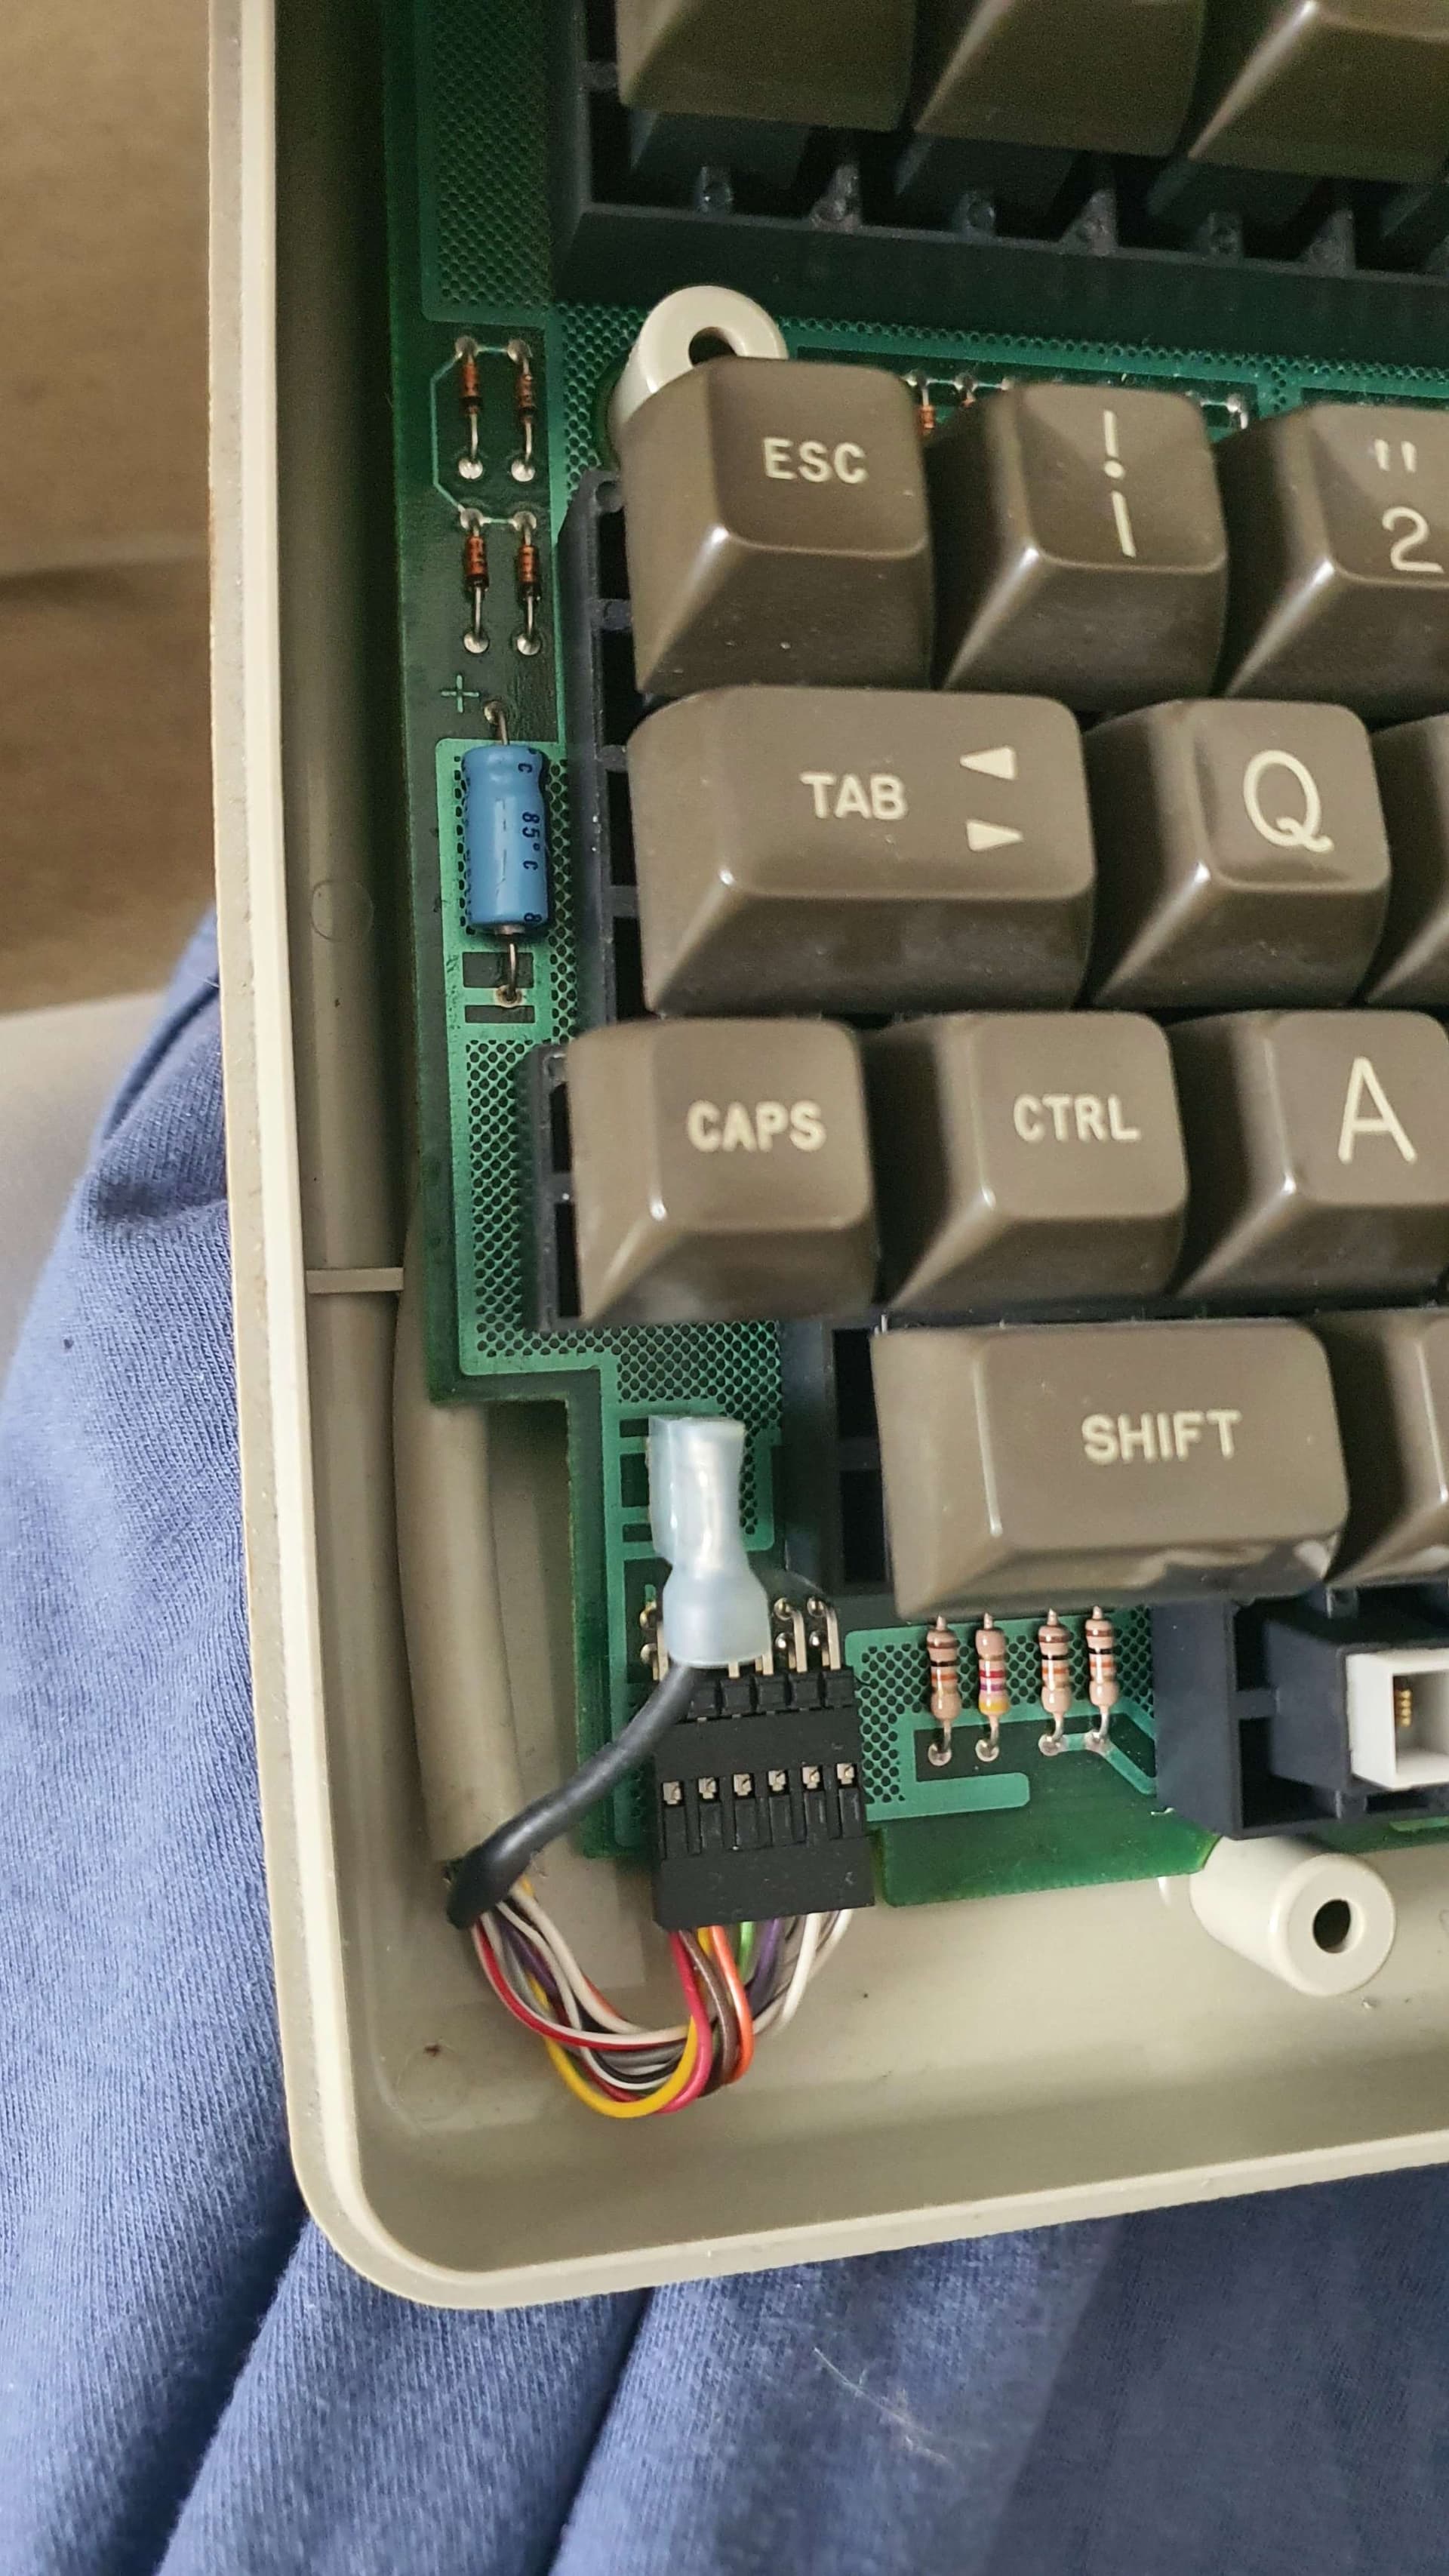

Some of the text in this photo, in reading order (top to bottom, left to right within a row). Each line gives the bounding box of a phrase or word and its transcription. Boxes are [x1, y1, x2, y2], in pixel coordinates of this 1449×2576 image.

[762, 436, 869, 485] ESC
[1383, 506, 1444, 574] 2
[799, 771, 909, 821] TAB
[1243, 750, 1334, 853] Q
[687, 1099, 828, 1153] CAPS
[1013, 1094, 1142, 1143] CTRL
[1338, 1057, 1419, 1165] A
[1081, 1409, 1242, 1466] SHIFT
